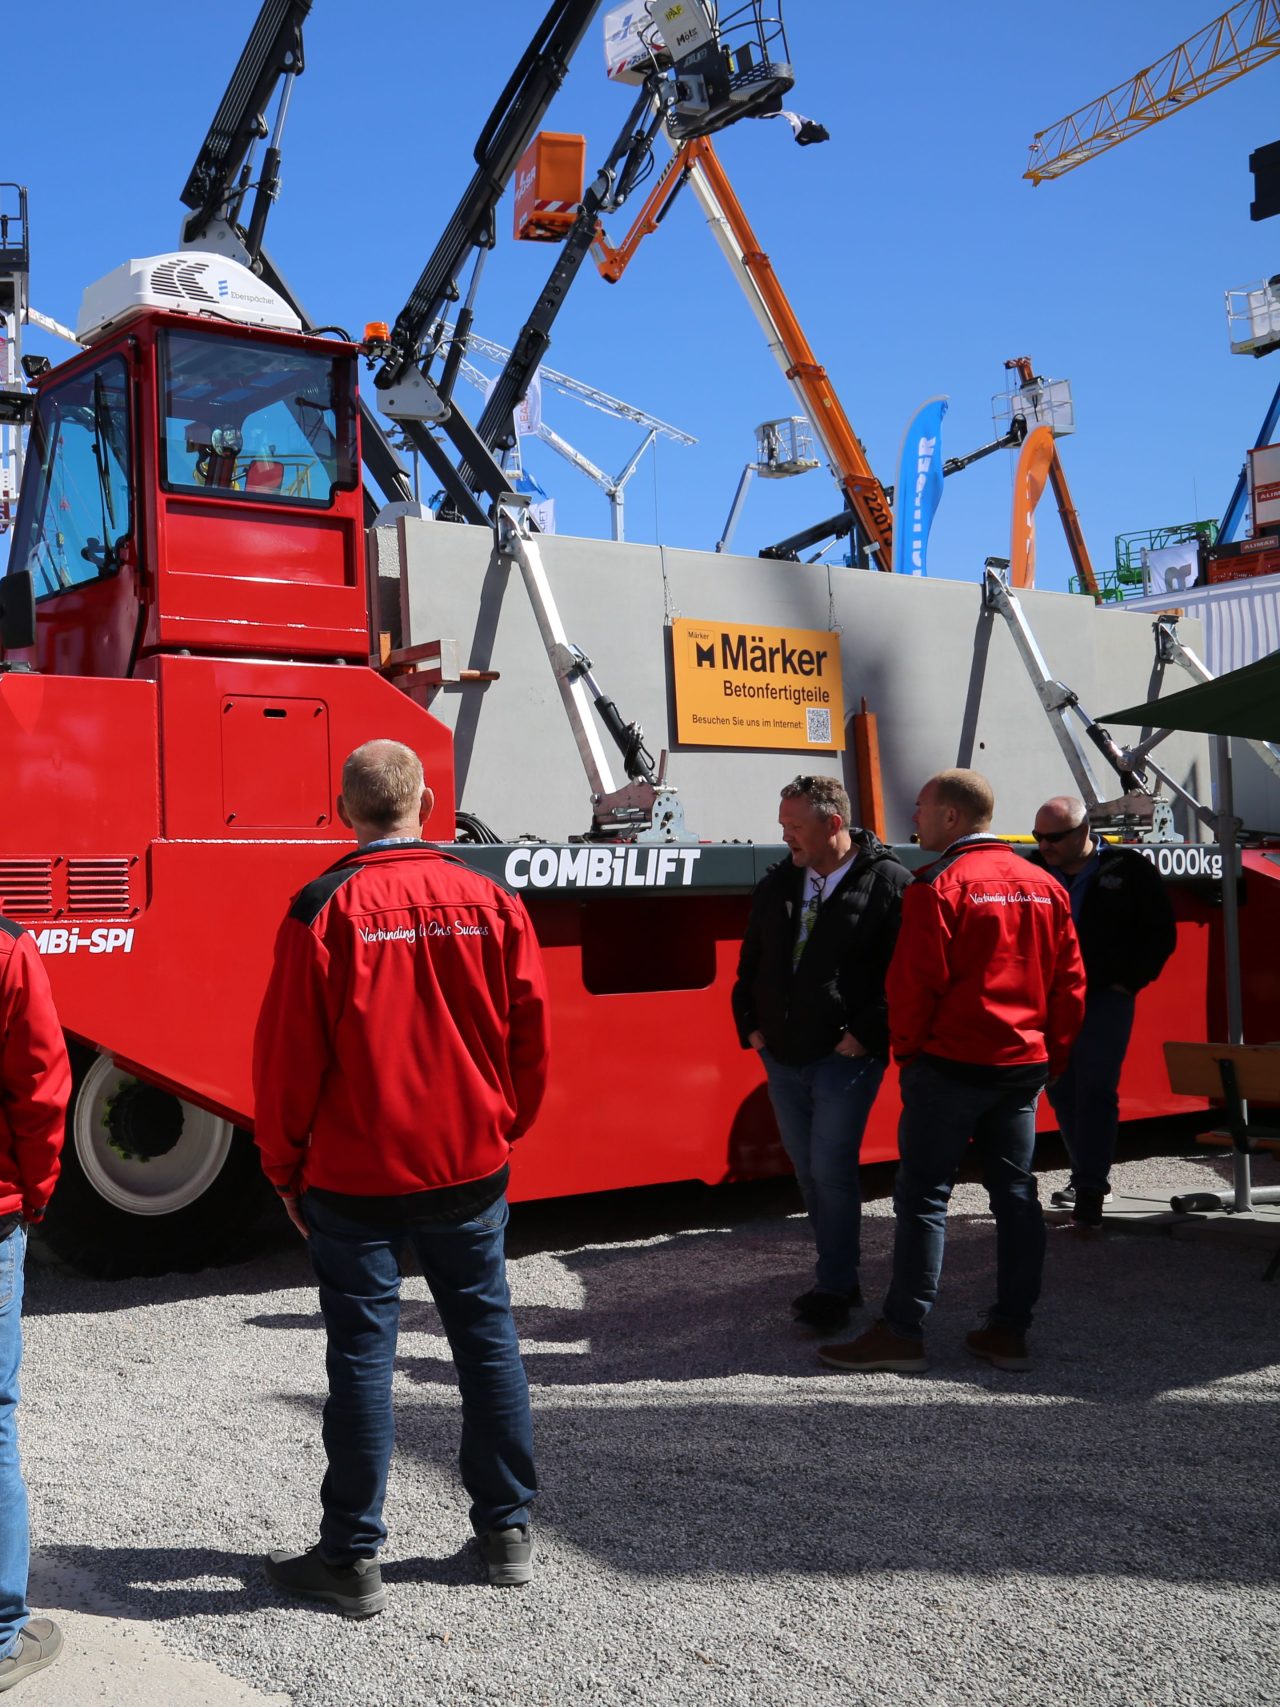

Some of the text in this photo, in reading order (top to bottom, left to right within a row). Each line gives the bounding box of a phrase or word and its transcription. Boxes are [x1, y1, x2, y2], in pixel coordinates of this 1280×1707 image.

[1243, 538, 1276, 551] ALIMAK
[687, 630, 710, 641] Märker
[720, 632, 828, 677] Märker
[723, 679, 831, 706] Betonfertigteile
[692, 713, 804, 730] Besuchen Sie uns im Internet:
[358, 925, 416, 944] Verbinding
[427, 921, 452, 937] Ons
[454, 919, 489, 937] Succes
